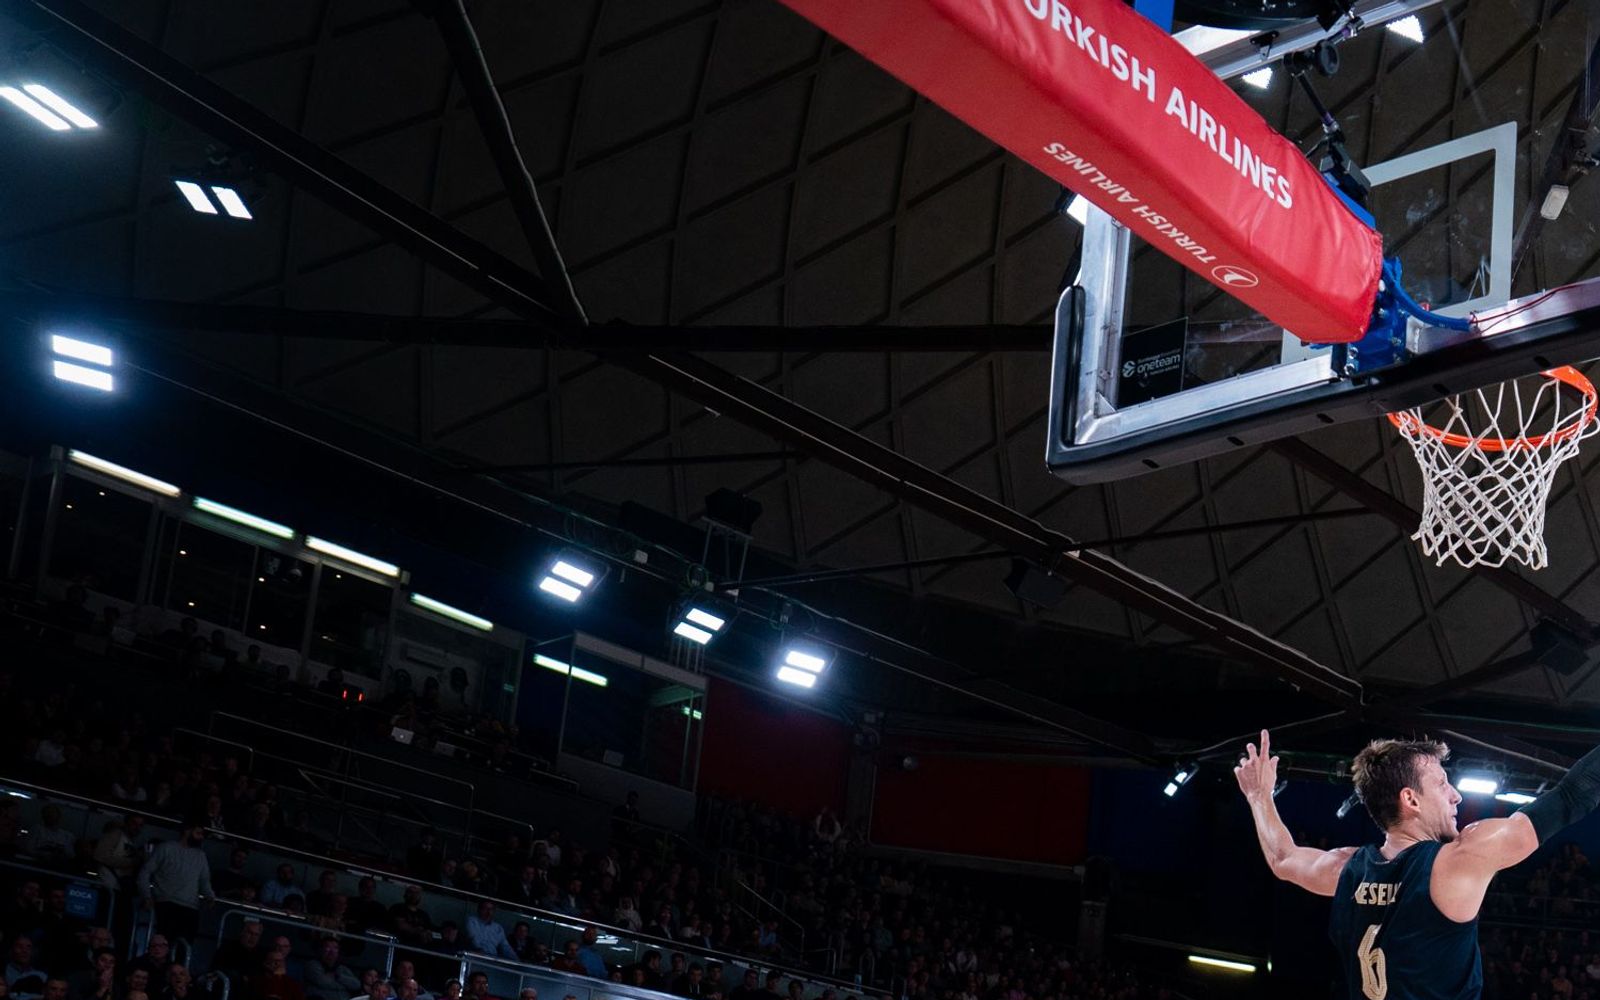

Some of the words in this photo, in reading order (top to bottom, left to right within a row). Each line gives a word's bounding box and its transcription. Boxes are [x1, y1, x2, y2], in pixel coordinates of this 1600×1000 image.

[1043, 141, 1139, 203] AIRLINES
[1165, 87, 1293, 210] AIRLINES
[1133, 197, 1215, 264] TURKISH
